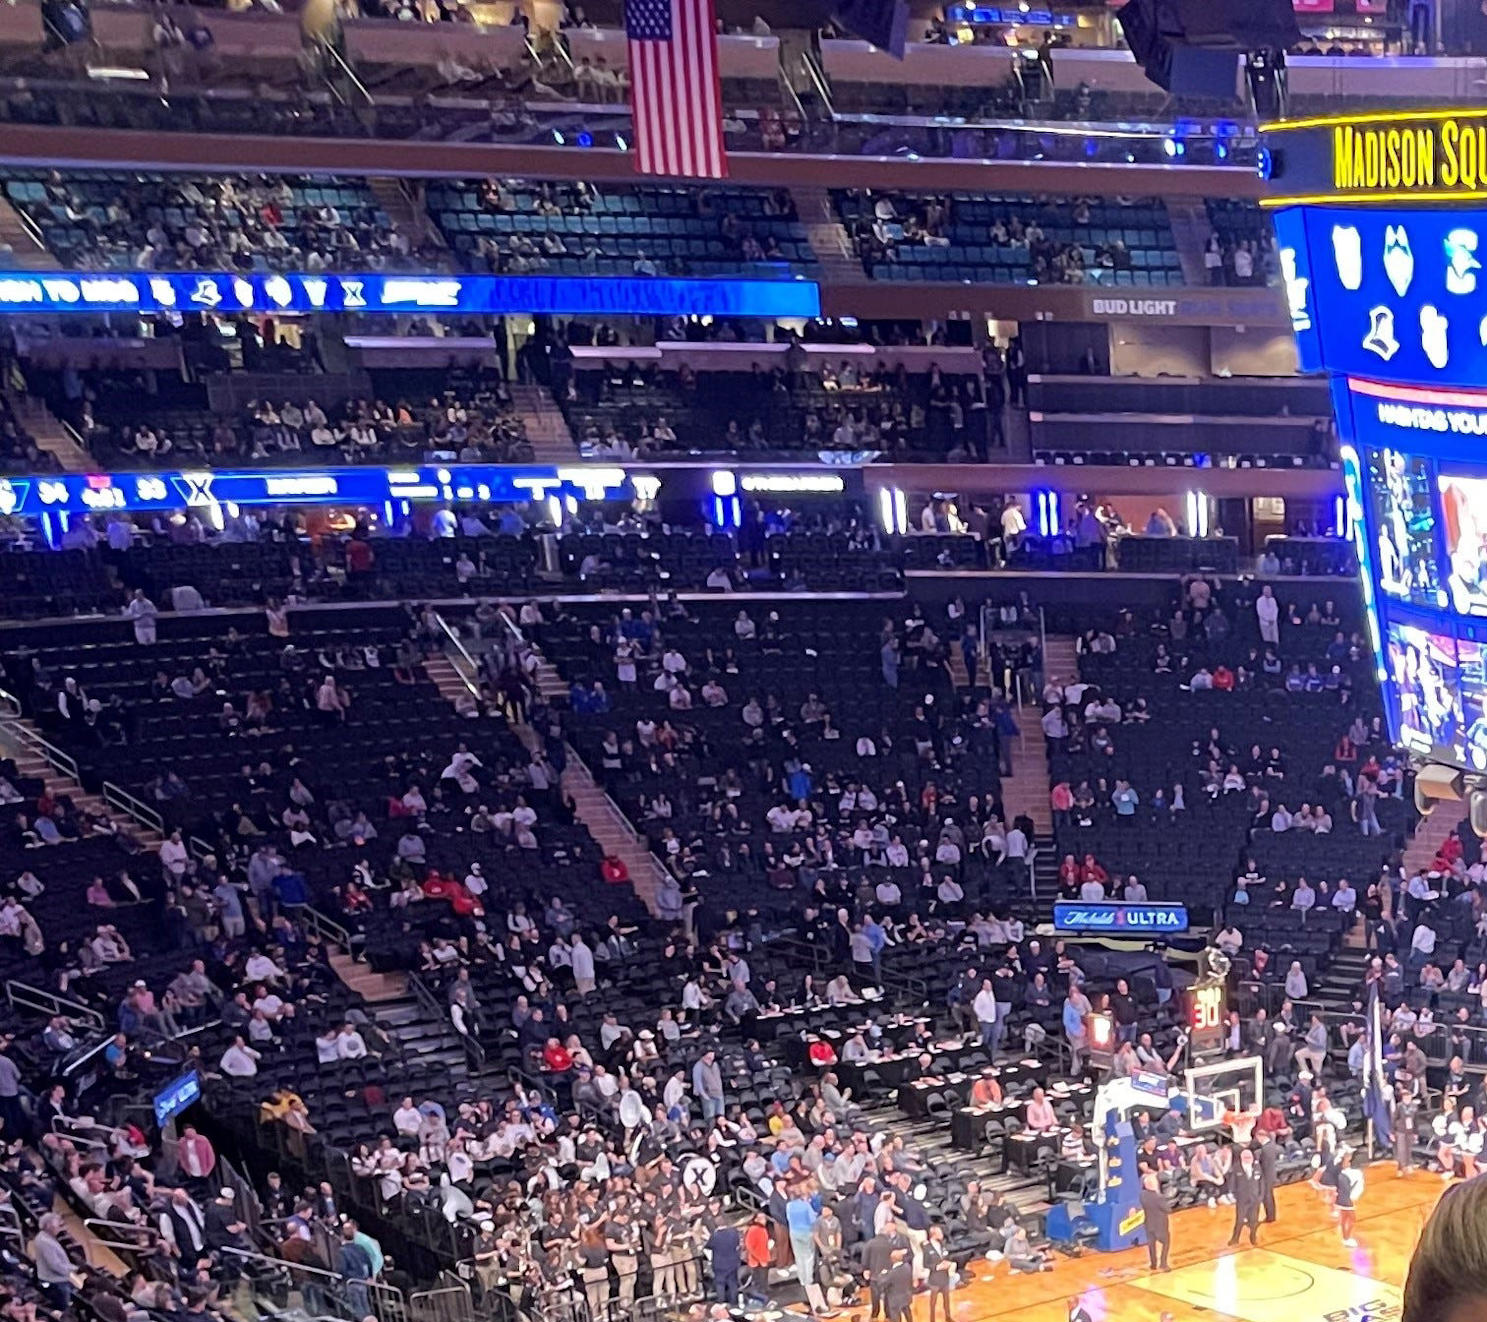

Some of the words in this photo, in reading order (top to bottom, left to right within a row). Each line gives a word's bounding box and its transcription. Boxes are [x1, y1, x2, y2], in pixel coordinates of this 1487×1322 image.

[1334, 126, 1434, 189] MADISON
[1093, 299, 1127, 315] BUD
[1129, 300, 1176, 316] LIGHT
[1126, 911, 1180, 925] ULTRA
